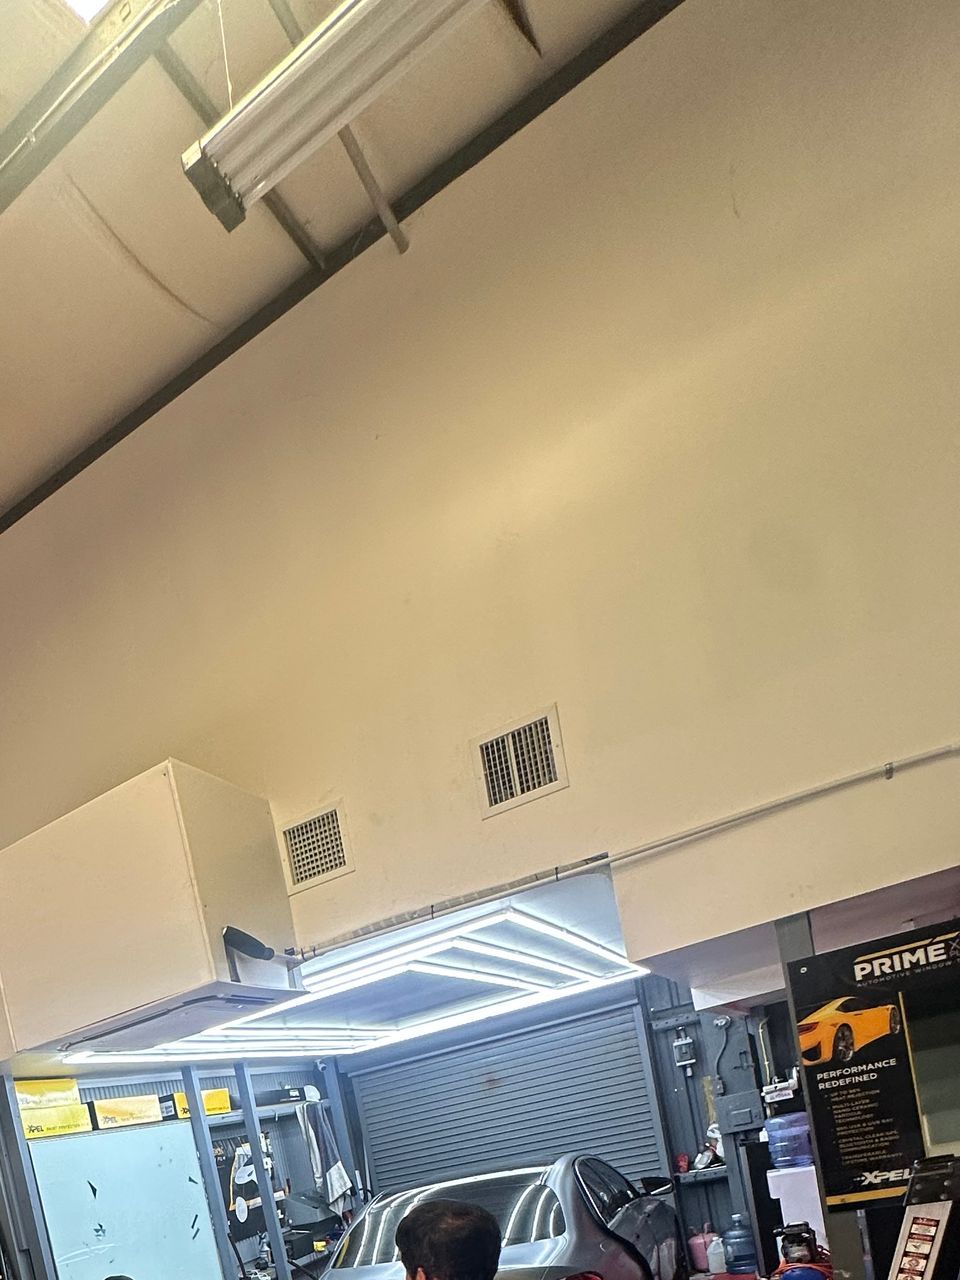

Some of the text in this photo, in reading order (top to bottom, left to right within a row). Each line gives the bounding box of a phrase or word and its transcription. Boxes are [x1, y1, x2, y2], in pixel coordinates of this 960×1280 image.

[854, 942, 947, 981] PRIME
[816, 1058, 897, 1081] PERFORMANCE
[818, 1072, 878, 1090] REDEFINED
[27, 1124, 44, 1133] XPEL
[860, 1169, 913, 1186] XPEL
